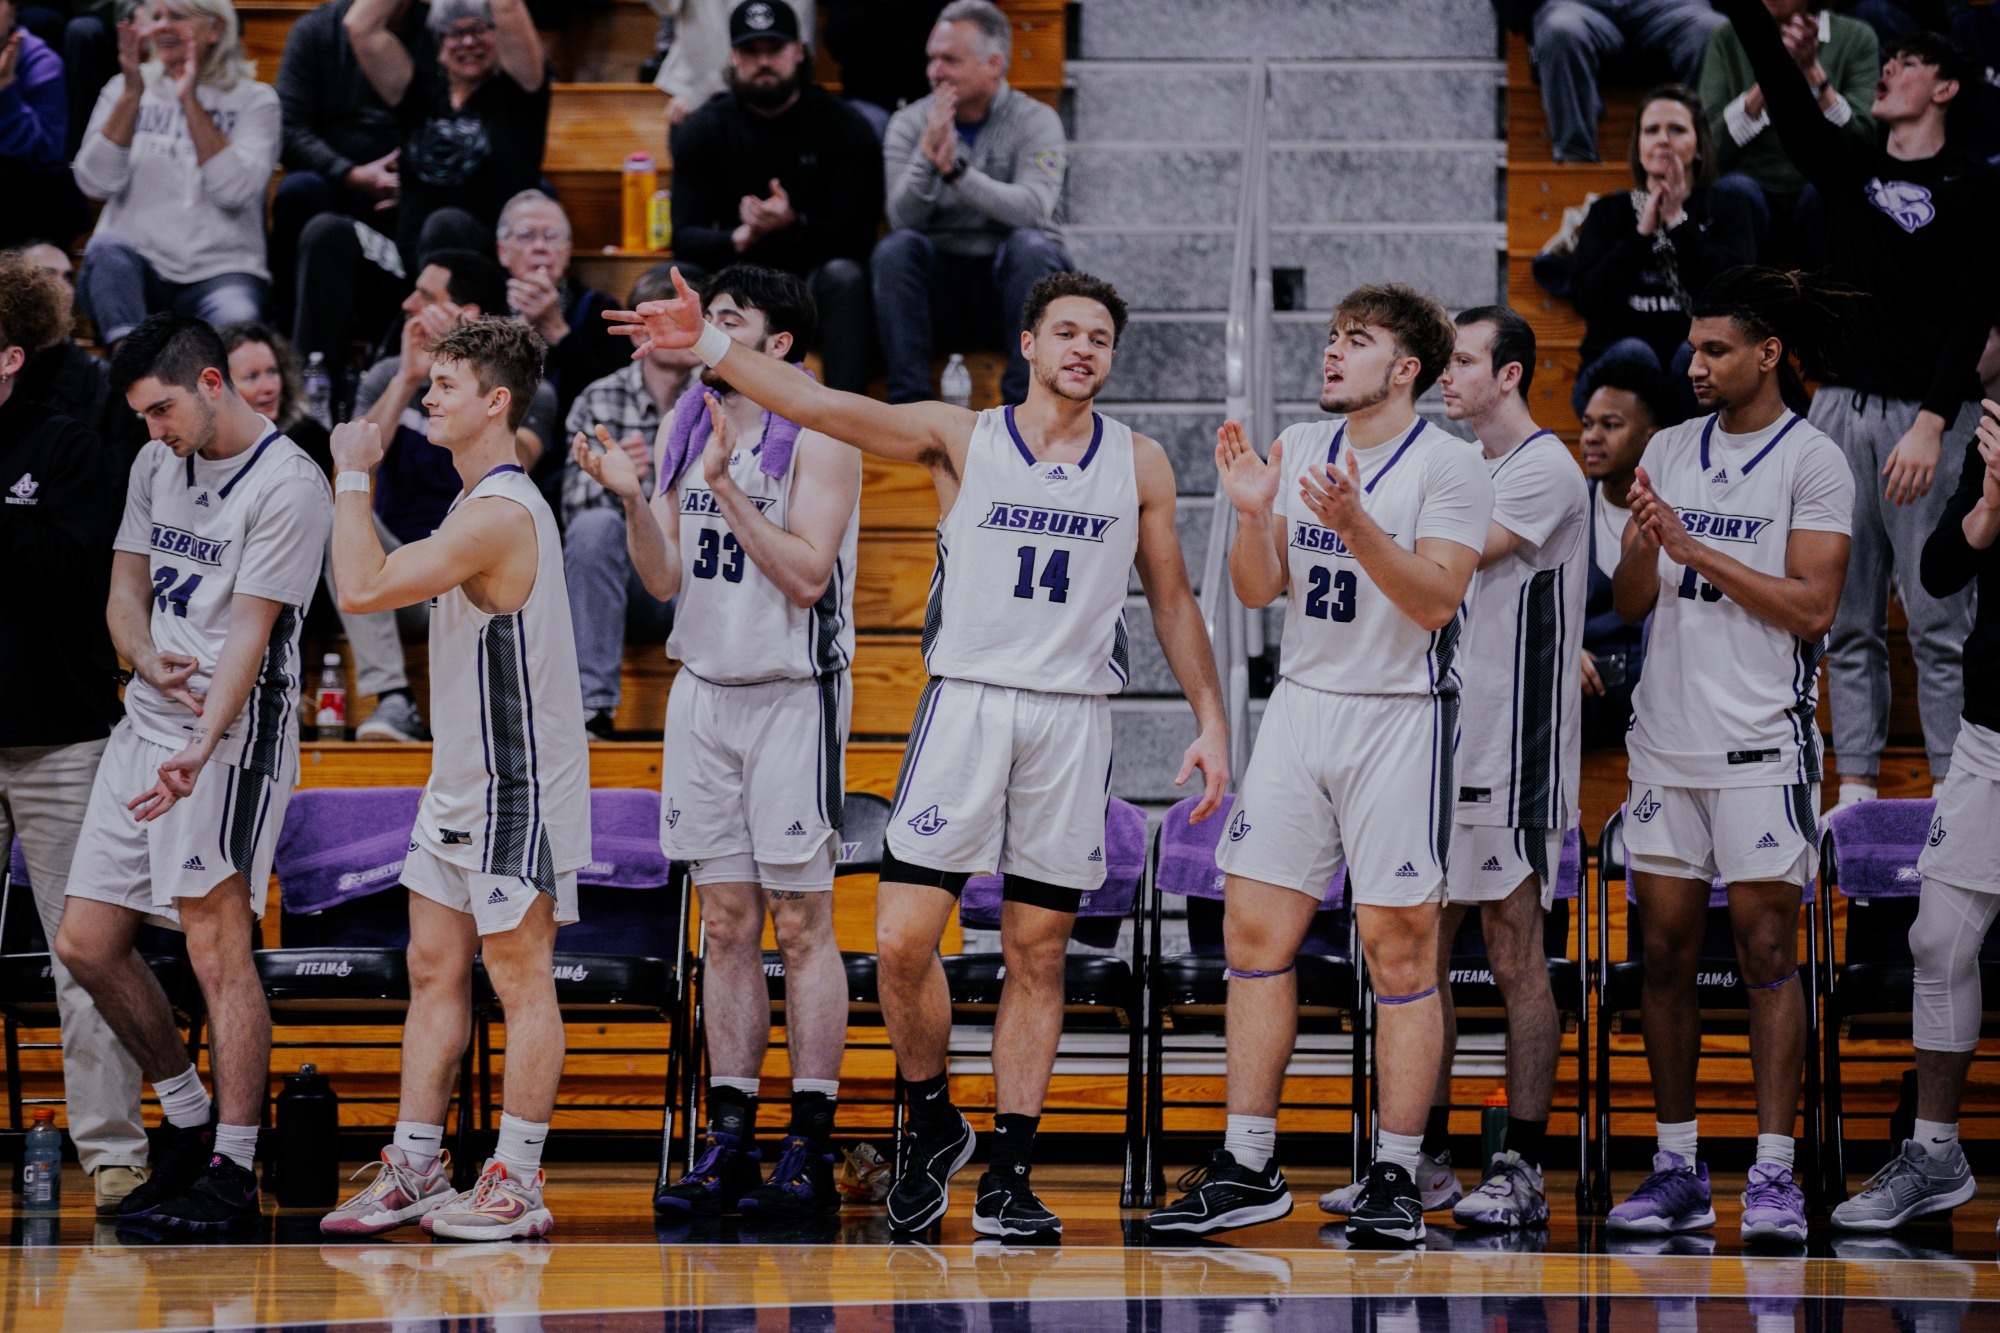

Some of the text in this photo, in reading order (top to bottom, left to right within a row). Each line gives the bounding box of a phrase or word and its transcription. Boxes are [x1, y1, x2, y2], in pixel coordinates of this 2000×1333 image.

[989, 507, 1109, 538] ASBURY
[1677, 512, 1762, 539] SBURY
[151, 527, 222, 562] ASBURY
[693, 528, 745, 583] 33
[153, 566, 204, 618] 24
[1014, 546, 1070, 603] 14
[1305, 565, 1357, 622] 23
[487, 896, 509, 904] adidas
[24, 1165, 34, 1183] G
